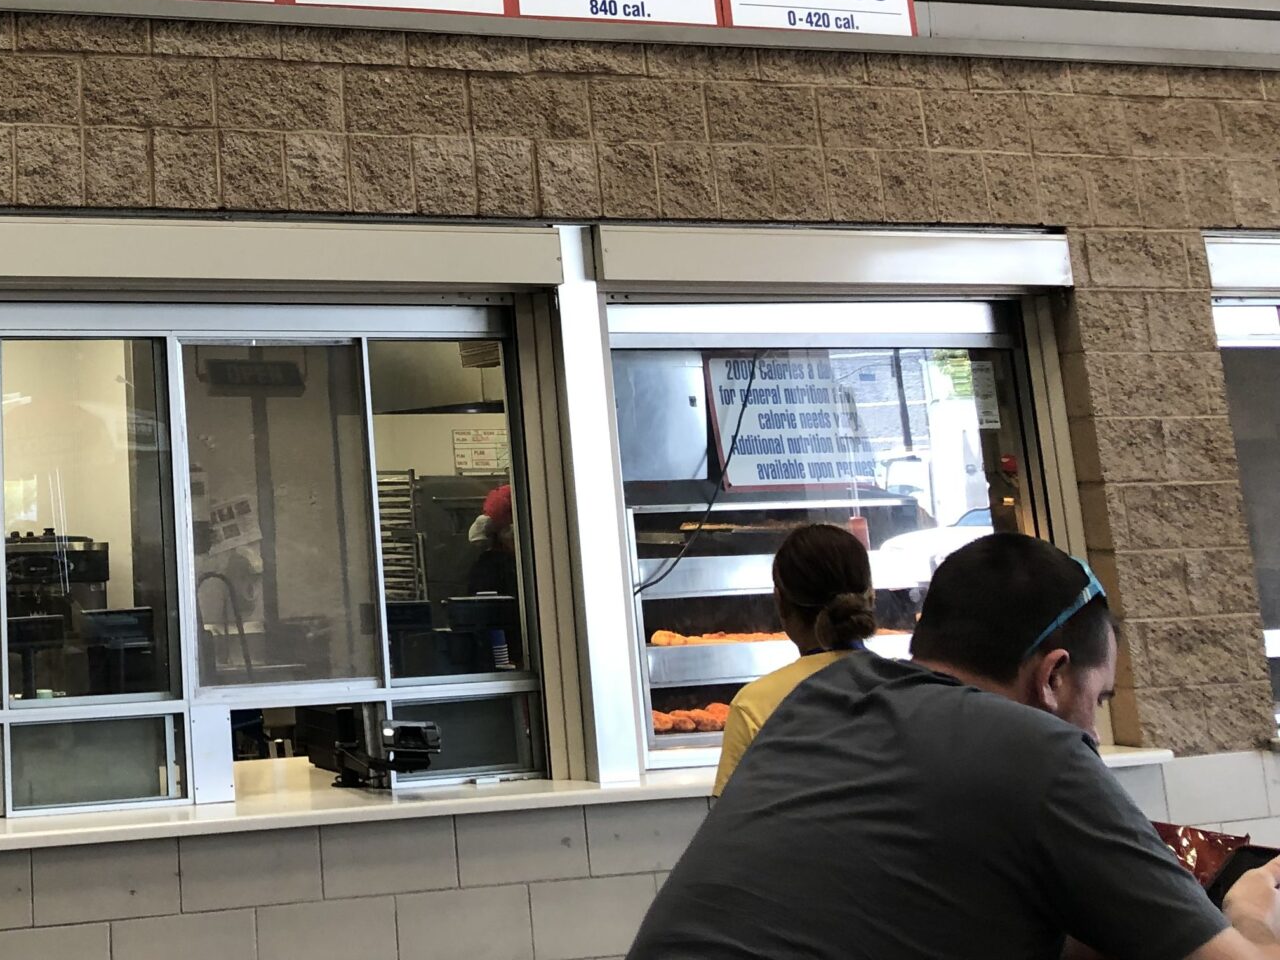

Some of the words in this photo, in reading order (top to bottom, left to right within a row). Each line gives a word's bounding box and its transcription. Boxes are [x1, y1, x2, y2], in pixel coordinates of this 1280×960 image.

[589, 0, 618, 16] 840
[622, 1, 651, 18] cal.
[834, 14, 859, 30] cal.
[759, 360, 804, 380] Calories
[719, 385, 736, 405] for
[740, 384, 782, 407] general
[784, 384, 830, 405] nutrition
[758, 409, 797, 430] calorie
[799, 408, 831, 429] needs
[731, 434, 785, 455] Additional
[788, 434, 833, 455] nutrition
[757, 459, 805, 480] available
[808, 461, 834, 482] upon
